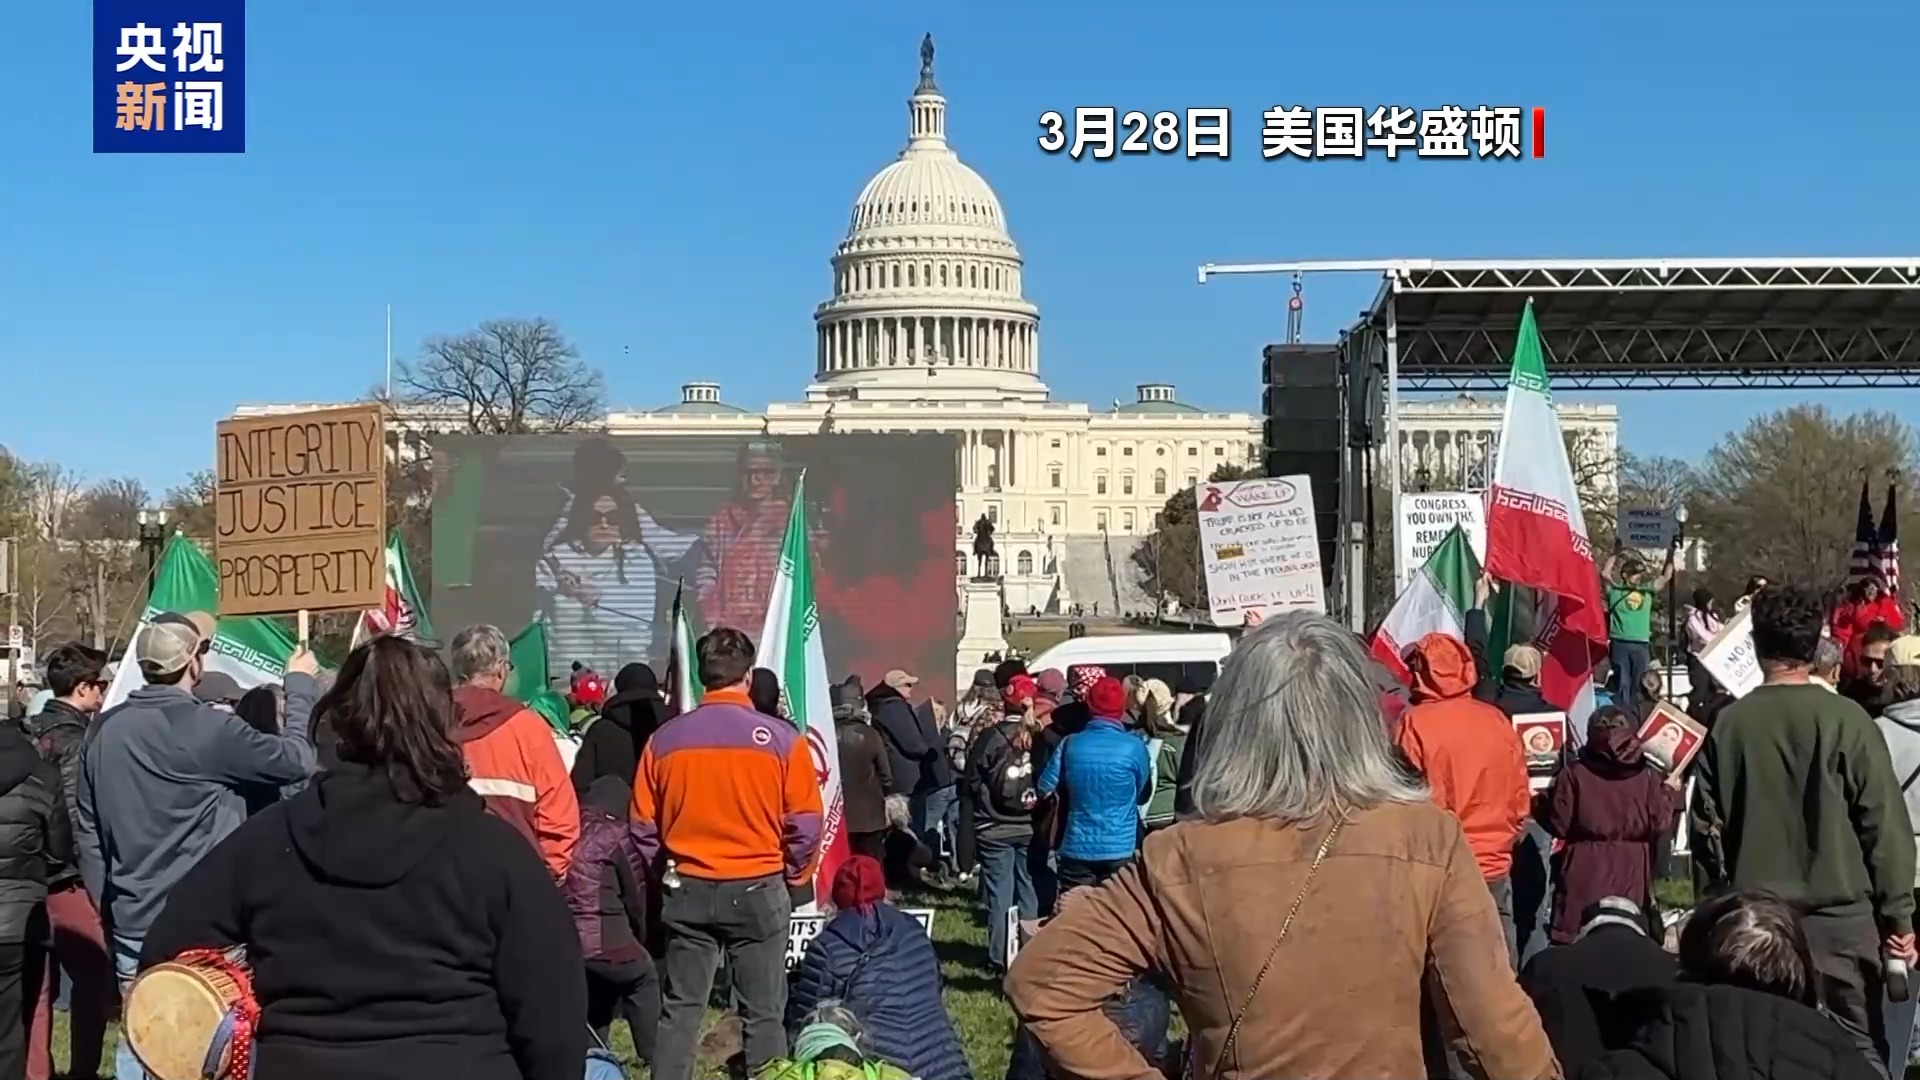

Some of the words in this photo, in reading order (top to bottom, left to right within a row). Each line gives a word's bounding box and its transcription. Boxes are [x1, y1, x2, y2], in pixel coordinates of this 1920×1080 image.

[219, 416, 376, 482] INTEGRITY
[218, 480, 376, 536] JUSTICE
[1406, 511, 1426, 525] YOU
[1428, 511, 1453, 523] OWN
[219, 547, 378, 601] PROSPERITY
[791, 921, 817, 936] IT'S
